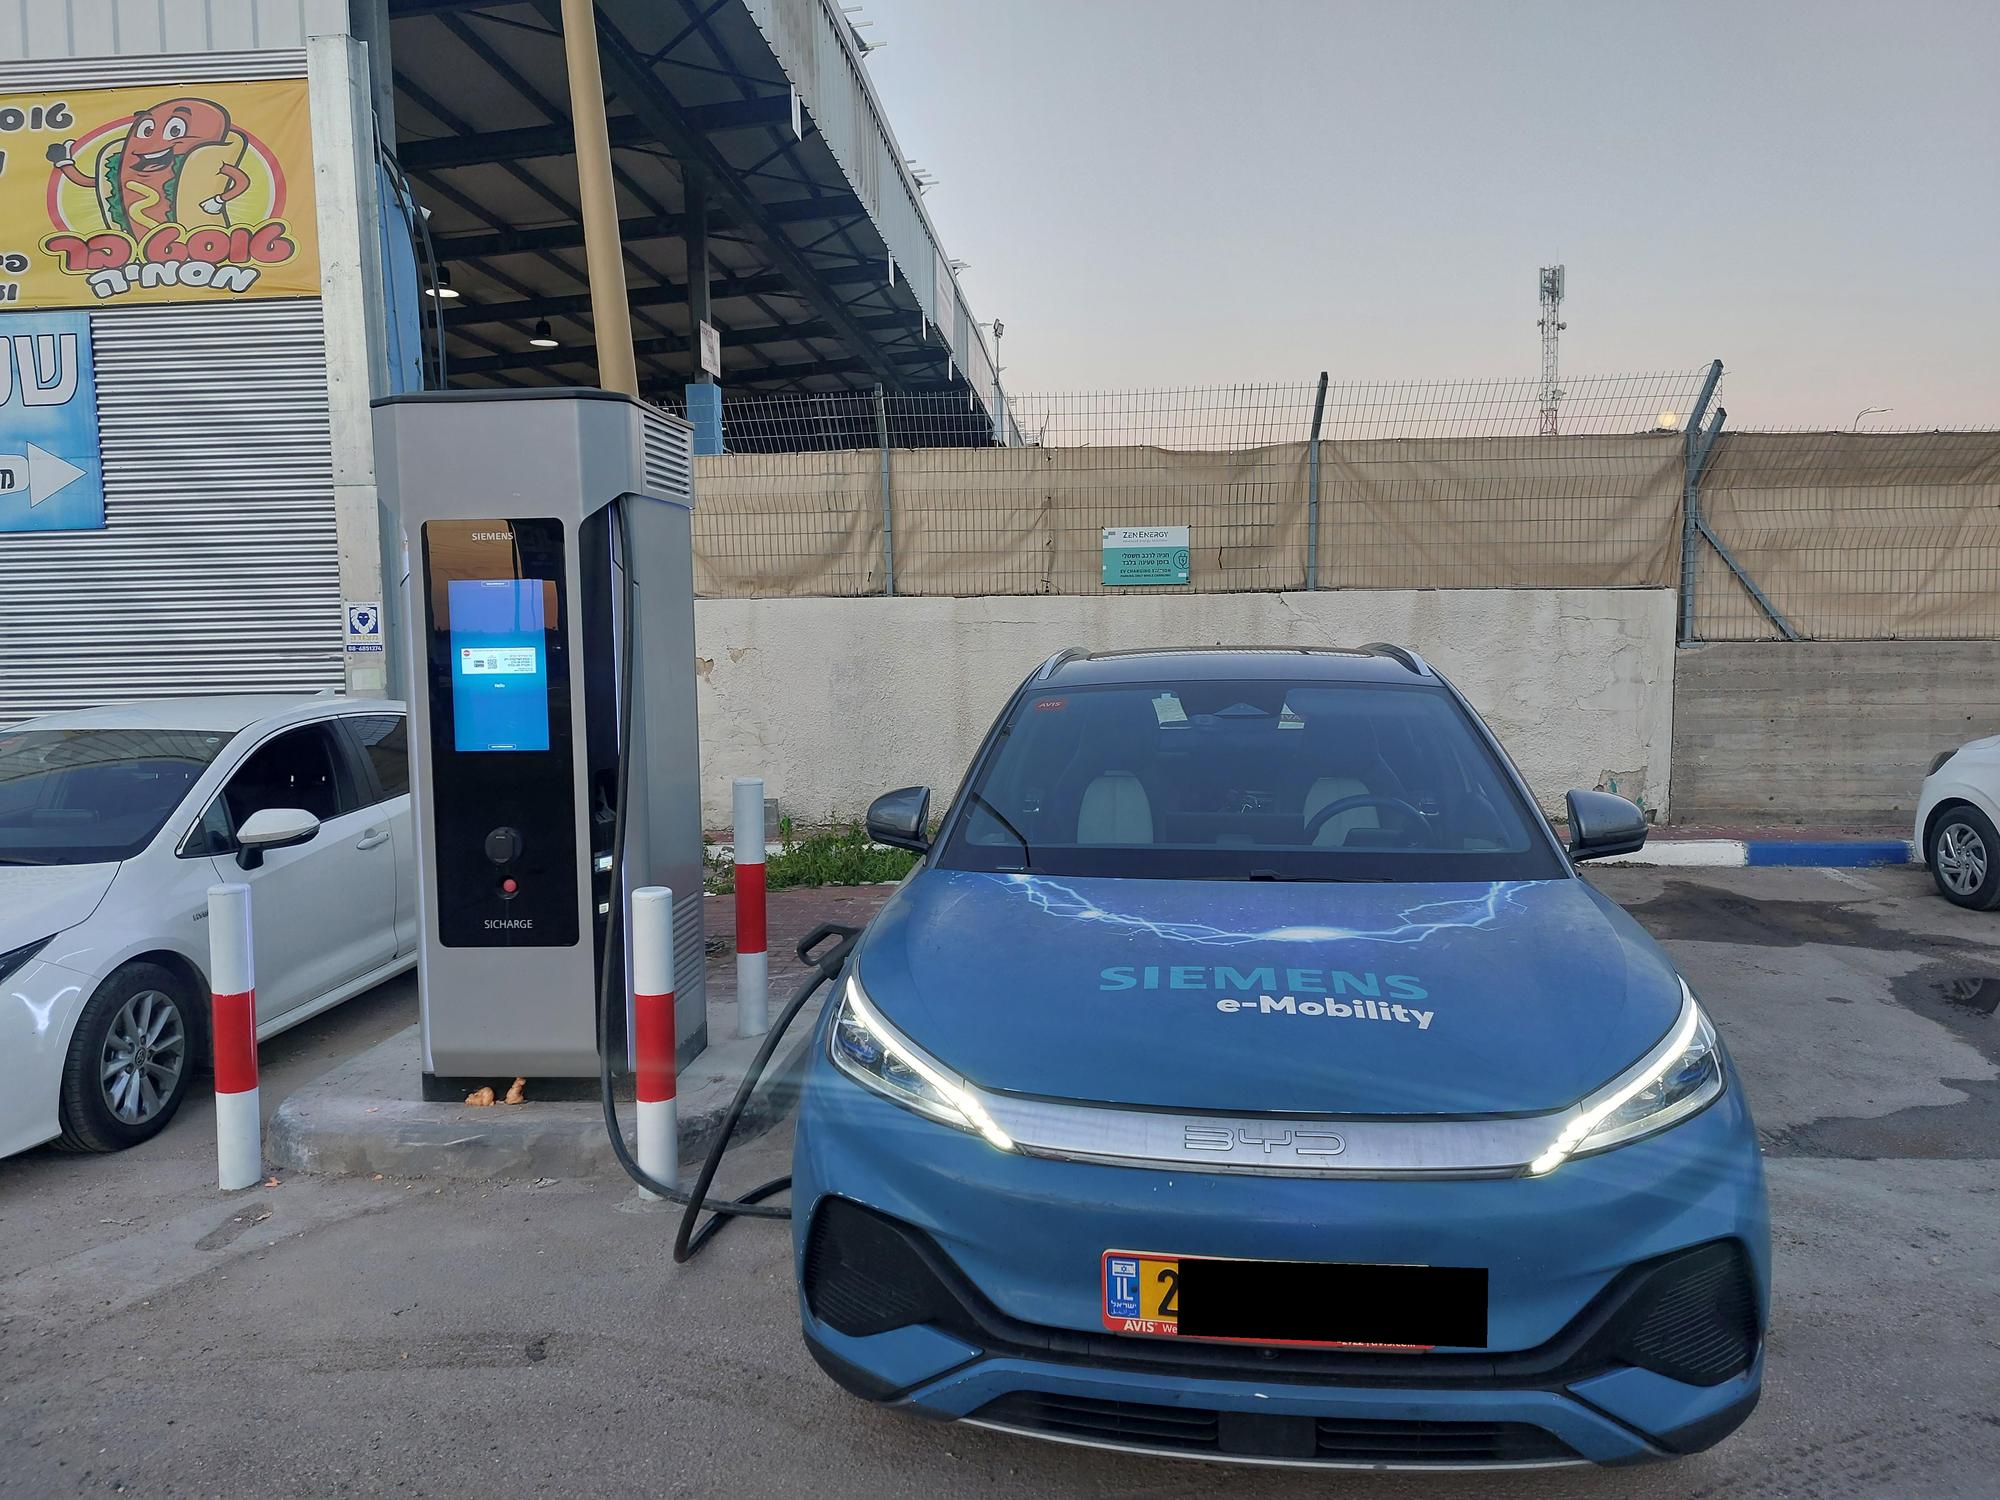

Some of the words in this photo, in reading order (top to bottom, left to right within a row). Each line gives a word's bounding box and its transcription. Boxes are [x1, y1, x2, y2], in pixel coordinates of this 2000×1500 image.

[45, 234, 133, 271] בר
[146, 222, 296, 263] טוסט
[86, 261, 261, 298] מסמיה
[472, 532, 513, 541] SIEMENS
[484, 919, 533, 929] SICHARGE
[1100, 966, 1429, 1000] SIEMENS
[1216, 995, 1434, 1030] e-Mobility
[1185, 1125, 1346, 1155] BYD
[1117, 1277, 1133, 1300] IL
[1111, 1300, 1136, 1309] ישראל
[1123, 1320, 1155, 1333] AVIS
